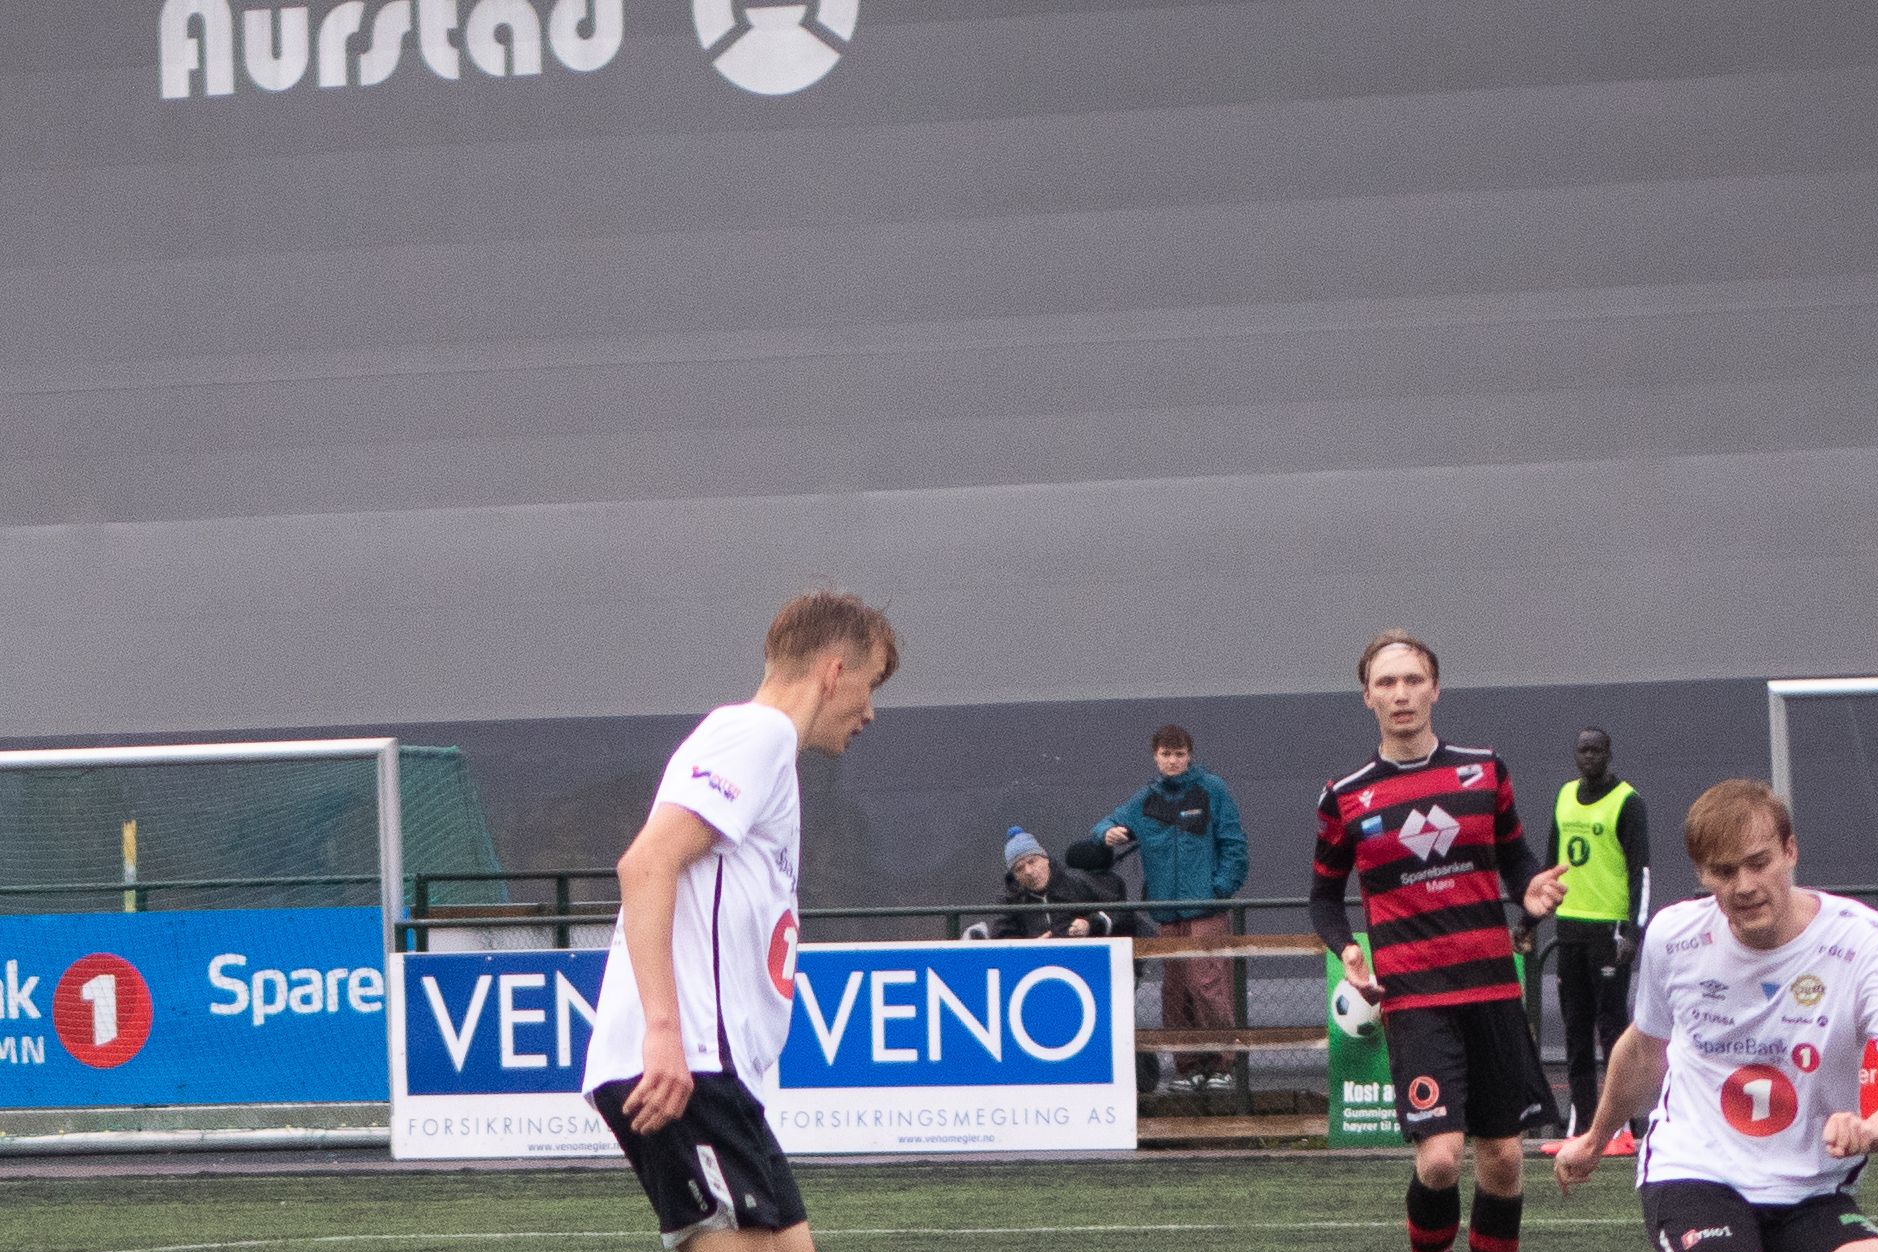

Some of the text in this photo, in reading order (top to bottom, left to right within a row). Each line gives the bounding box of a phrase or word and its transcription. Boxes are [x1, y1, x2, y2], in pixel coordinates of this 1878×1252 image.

[159, 0, 626, 99] Aurstad
[82, 973, 118, 1047] 1
[208, 953, 384, 1026] Spare
[795, 965, 1097, 1067] VENO
[421, 970, 597, 1073] VEN
[0, 1035, 45, 1064] MN
[1343, 1081, 1380, 1103] Kost
[1743, 1078, 1773, 1123] 1
[409, 1115, 601, 1136] FORSIKRINGSM
[780, 1106, 1117, 1129] FORSIKRINGSMEGLING AS
[1380, 1121, 1391, 1131] til
